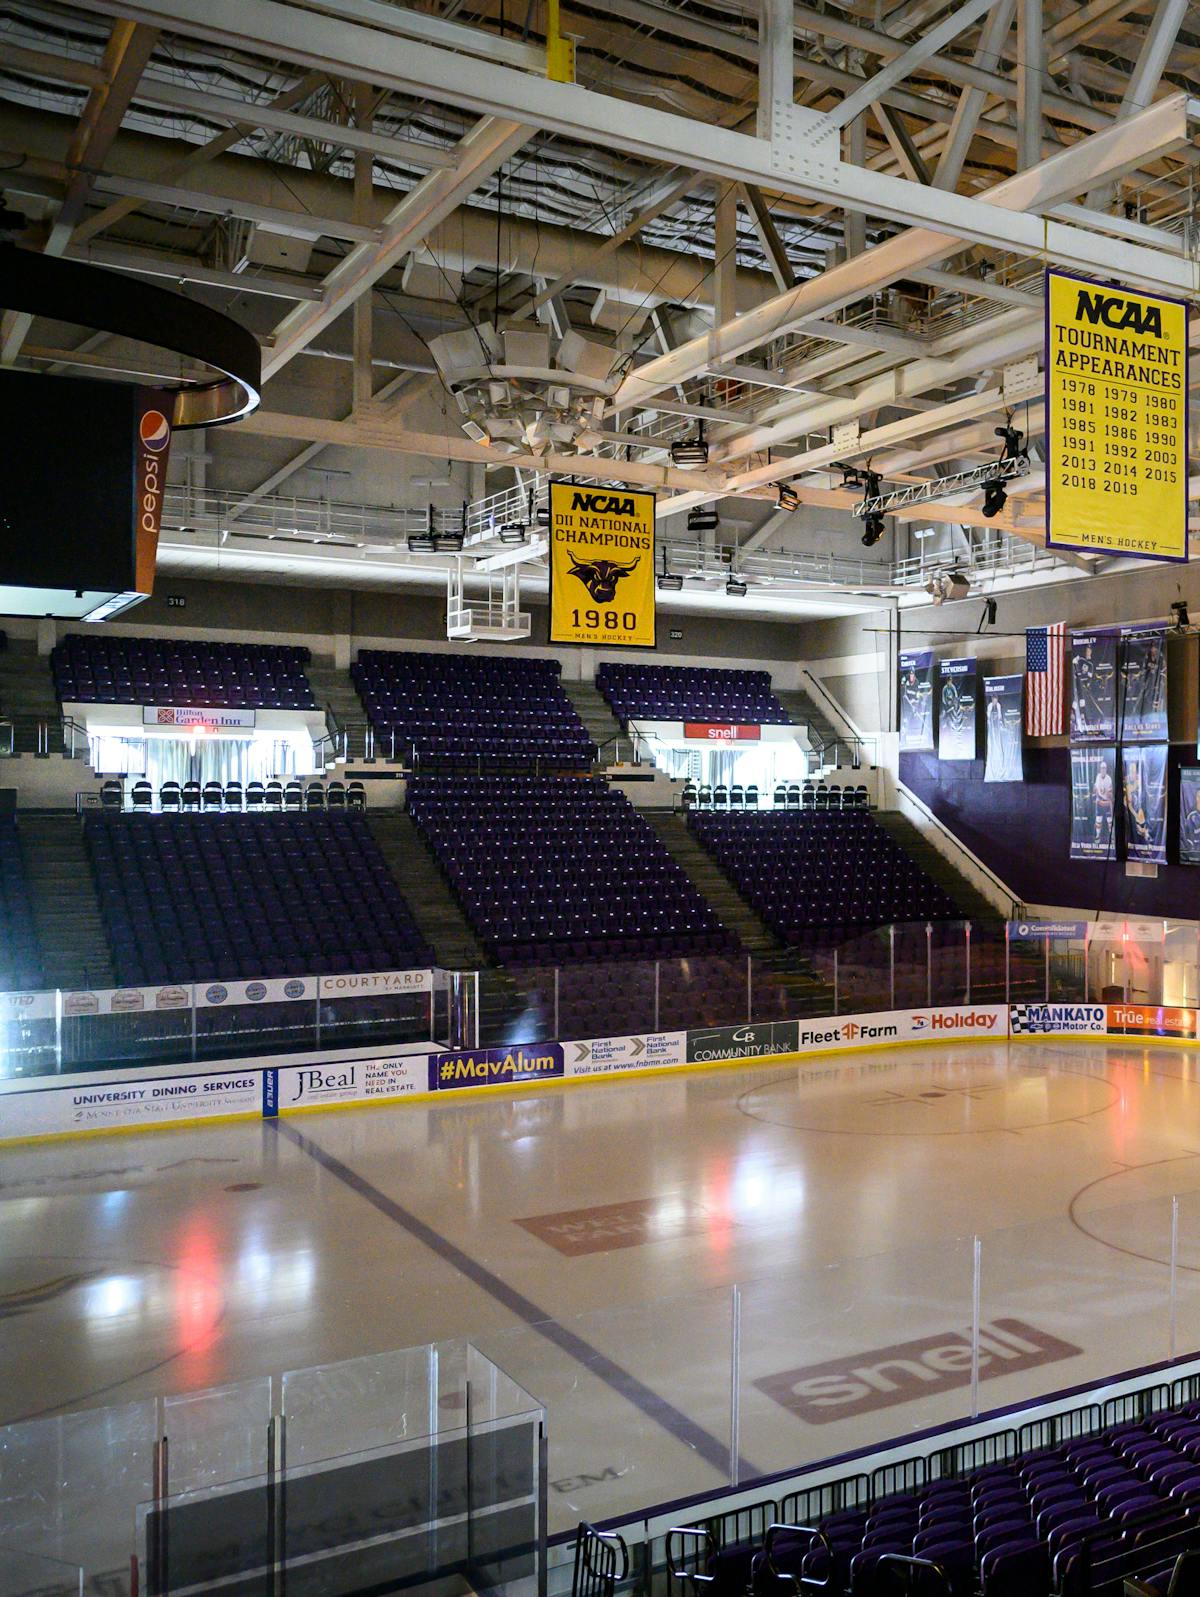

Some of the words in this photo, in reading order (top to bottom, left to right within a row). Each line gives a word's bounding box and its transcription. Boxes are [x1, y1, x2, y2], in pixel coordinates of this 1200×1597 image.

[1075, 290, 1162, 338] NCAA
[1056, 325, 1181, 366] TOURNAMENT
[1056, 350, 1181, 389] APPEARANCES
[1062, 379, 1095, 396] 1978
[1105, 387, 1137, 404] 1979
[1146, 395, 1176, 411] 1980
[1062, 398, 1095, 415] 1981
[1105, 405, 1137, 422] 1982
[1146, 413, 1177, 429] 1983
[1062, 417, 1096, 434] 1985
[1105, 425, 1137, 441] 1986
[1146, 431, 1176, 447] 1990
[1062, 436, 1095, 452] 1991
[1105, 443, 1137, 459] 1992
[1145, 450, 1177, 465] 2003
[1062, 455, 1096, 471] 2013
[1104, 462, 1137, 477] 2014
[1145, 468, 1177, 483] 2015
[142, 453, 160, 532] pepsi
[1062, 474, 1096, 490] 2018
[1104, 480, 1137, 495] 2019
[571, 493, 635, 516] NCAA
[556, 514, 573, 526] DII
[580, 516, 650, 534] NATIONAL
[556, 529, 650, 549] CHAMPIONS
[1082, 533, 1113, 546] MEN'S
[1118, 537, 1158, 550] HOCKEY
[169, 598, 185, 606] 318
[572, 609, 636, 630] 1980
[176, 709, 202, 717] Hilton
[176, 716, 218, 725] Garden
[221, 717, 241, 726] Inn
[708, 726, 737, 739] snell
[1030, 924, 1077, 933] Consolidated
[325, 973, 423, 989] COURTYARD
[931, 1012, 997, 1029] Holiday
[1028, 1007, 1104, 1022] MANKATO
[802, 1029, 840, 1044] Fleet
[860, 1024, 897, 1038] Farm
[1062, 1022, 1088, 1031] Motor
[1091, 1022, 1104, 1031] Co.
[592, 1046, 626, 1054] National
[646, 1040, 680, 1048] National
[694, 1044, 761, 1061] COMMUNITY
[764, 1042, 792, 1054] BANK
[383, 1062, 404, 1070] ONLY
[440, 1052, 554, 1080] #MavAlum
[574, 1066, 590, 1074] Visit
[614, 1057, 679, 1070] www.fnbmn.com
[74, 1090, 145, 1106] UNIVERSITY
[152, 1085, 197, 1098] DINING
[204, 1078, 256, 1092] SERVICES
[366, 1087, 384, 1095] REAL
[792, 1324, 1044, 1406] snell
